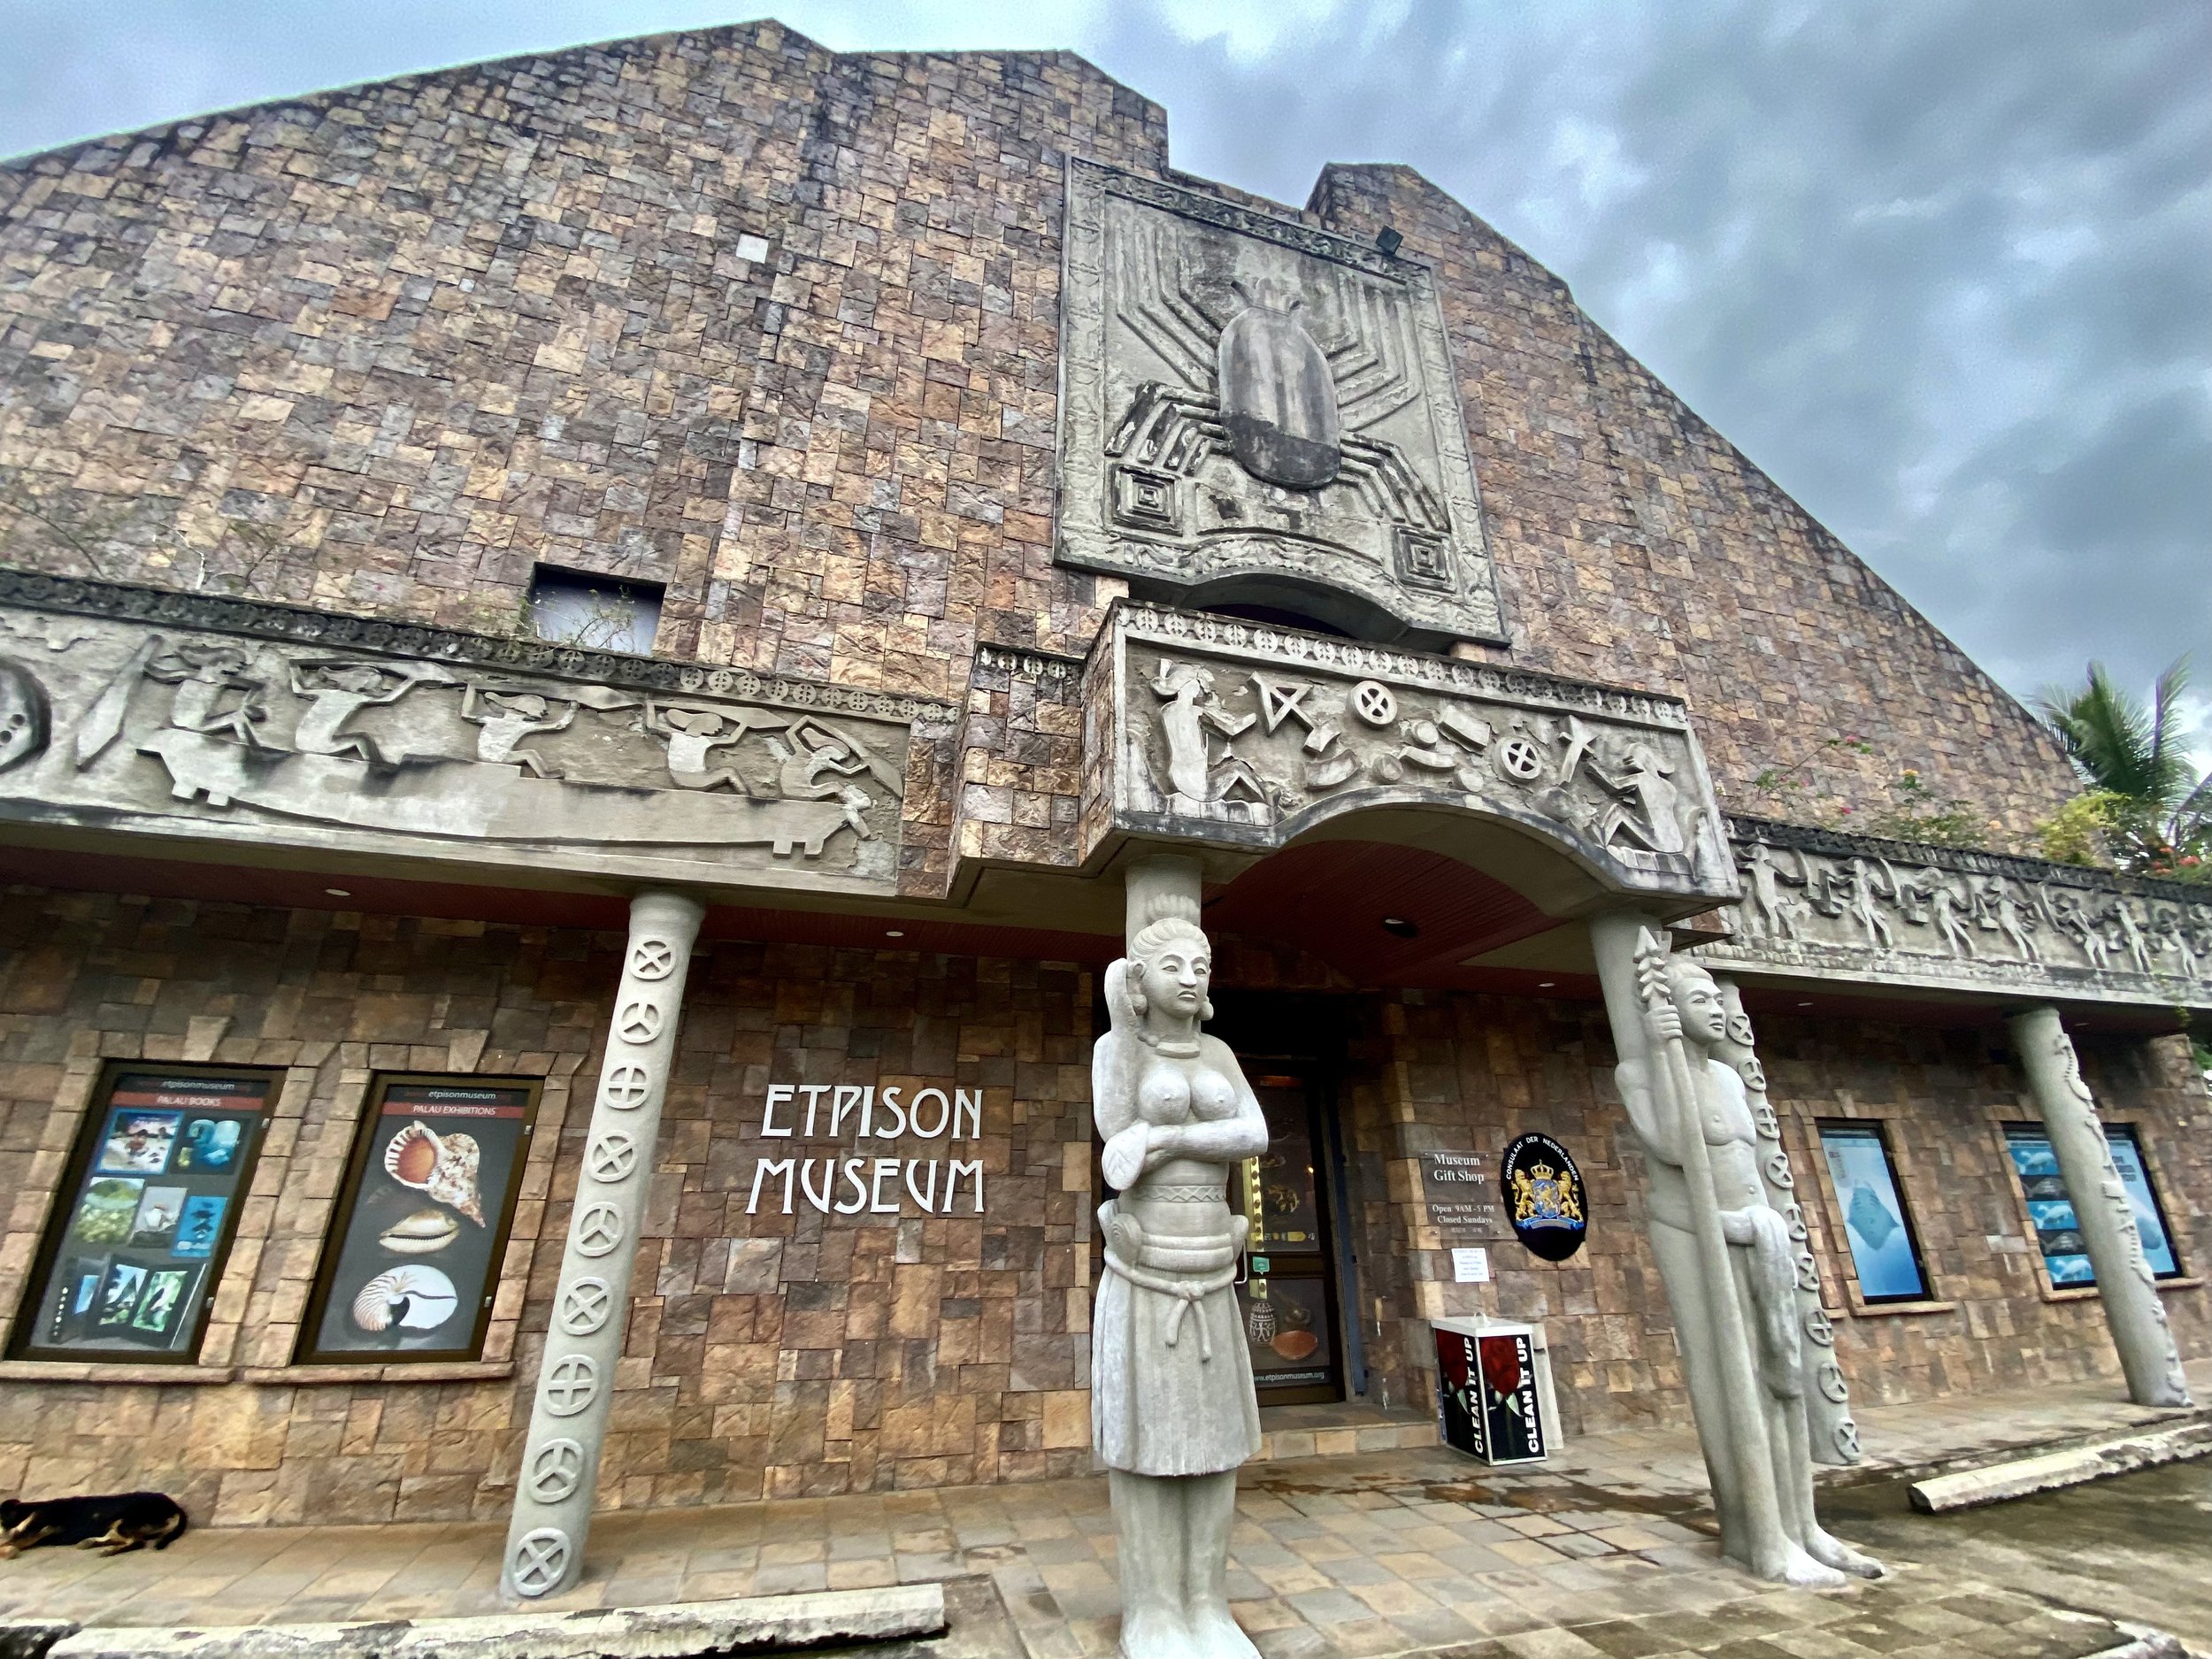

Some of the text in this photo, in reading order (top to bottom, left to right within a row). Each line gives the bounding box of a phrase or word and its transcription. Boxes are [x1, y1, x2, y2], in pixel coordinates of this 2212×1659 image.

[162, 1080, 234, 1090] etpisonmuseum
[157, 1095, 222, 1106] PALAU BOOKS
[428, 1091, 496, 1100] etpisonmuseum
[412, 1105, 496, 1116] PALAU EXHIBITIONS
[760, 1084, 983, 1140] ETPISON
[1434, 1154, 1480, 1166] Museum
[1506, 1135, 1579, 1181] CONSULAAT DER NEDERLANDEN
[1433, 1169, 1485, 1185] Gift Shop
[745, 1157, 985, 1215] MUSEUM
[1432, 1203, 1452, 1214] Open
[1437, 1215, 1493, 1225] Closed Sundays
[1254, 1371, 1325, 1382] ww.etpisonmuseum.org
[1463, 1337, 1484, 1454] CLEAN IT UP
[1516, 1337, 1540, 1453] CLEAN IT UP
